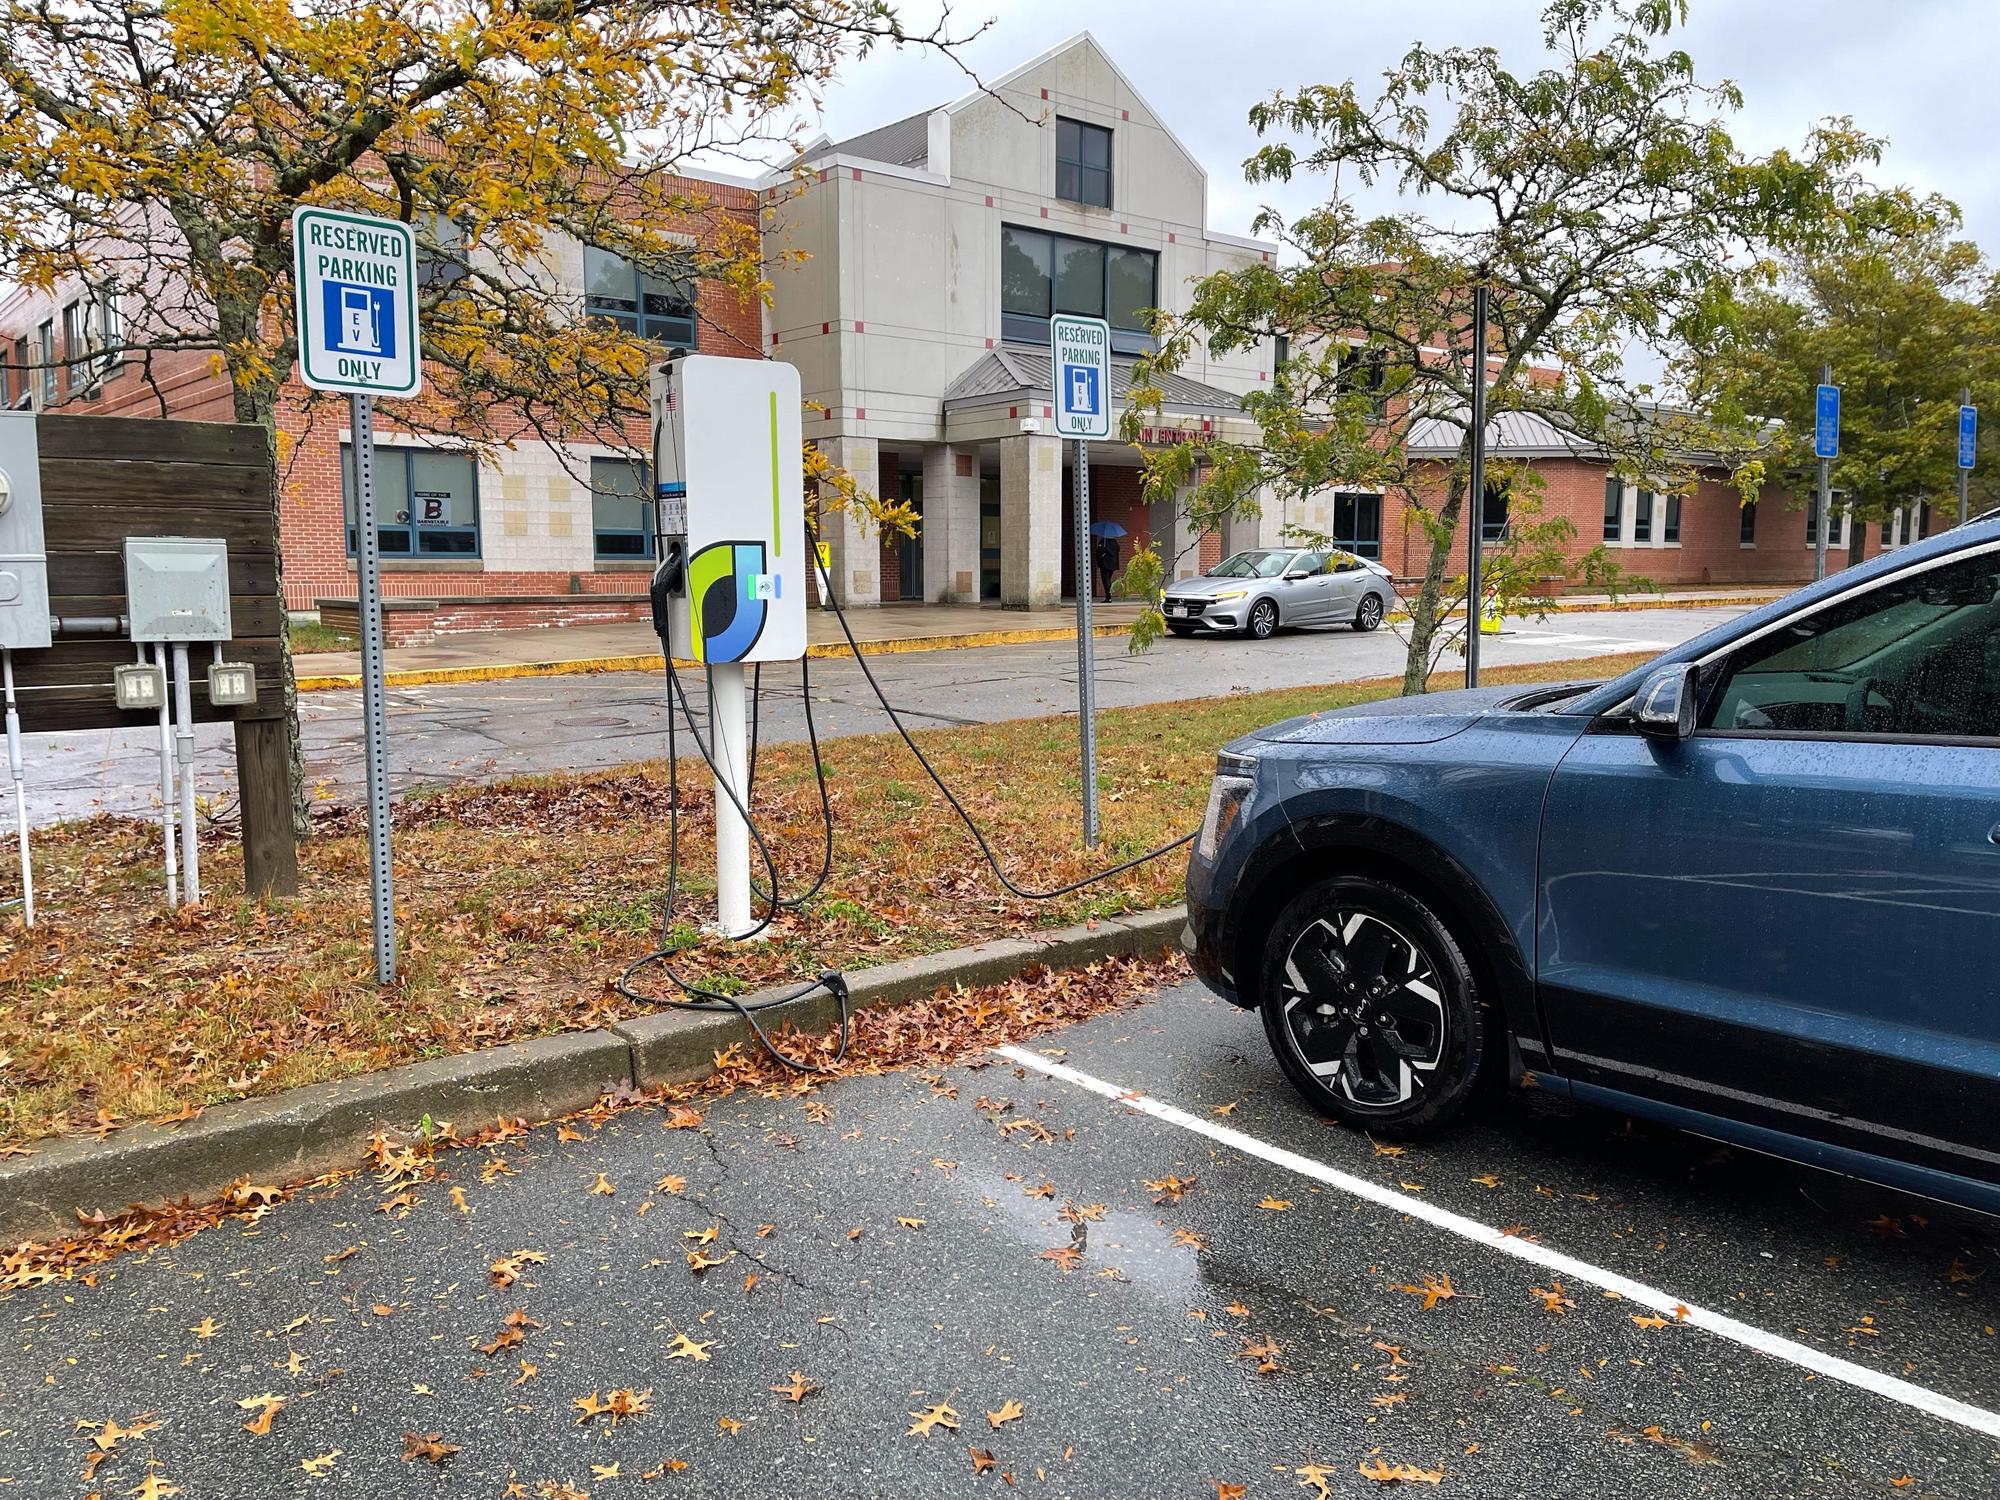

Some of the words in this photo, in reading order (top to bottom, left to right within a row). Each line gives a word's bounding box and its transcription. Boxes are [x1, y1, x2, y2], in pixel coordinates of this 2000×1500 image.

[310, 223, 402, 258] RESERVED
[318, 254, 397, 287] PARKING
[1058, 326, 1103, 345] RESERVED
[1062, 347, 1100, 365] PARKING
[338, 358, 381, 380] ONLY
[1071, 416, 1093, 430] ONLY
[423, 498, 442, 519] B
